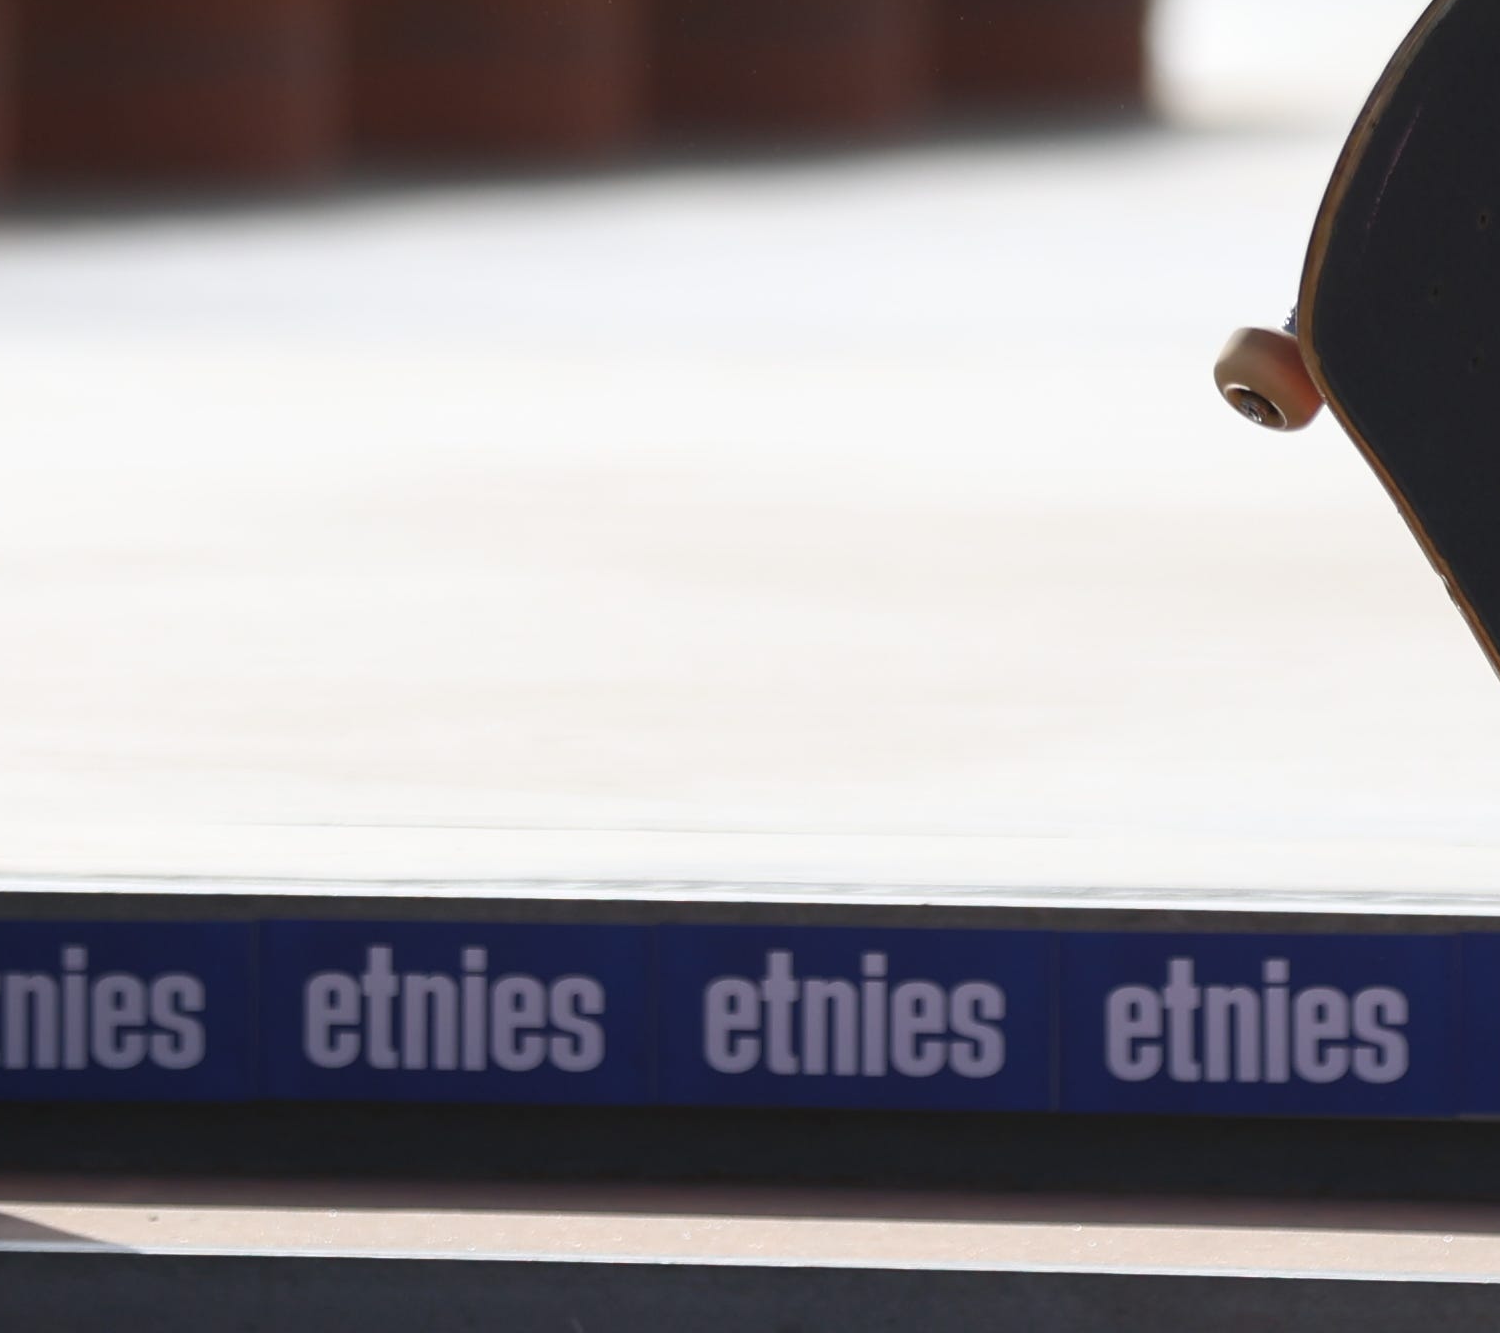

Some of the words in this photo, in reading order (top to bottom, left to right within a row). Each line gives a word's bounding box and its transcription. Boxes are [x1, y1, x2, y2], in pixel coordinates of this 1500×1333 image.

[305, 945, 606, 1073] etnies
[704, 950, 1007, 1079] etnies
[1106, 957, 1409, 1084] etnies
